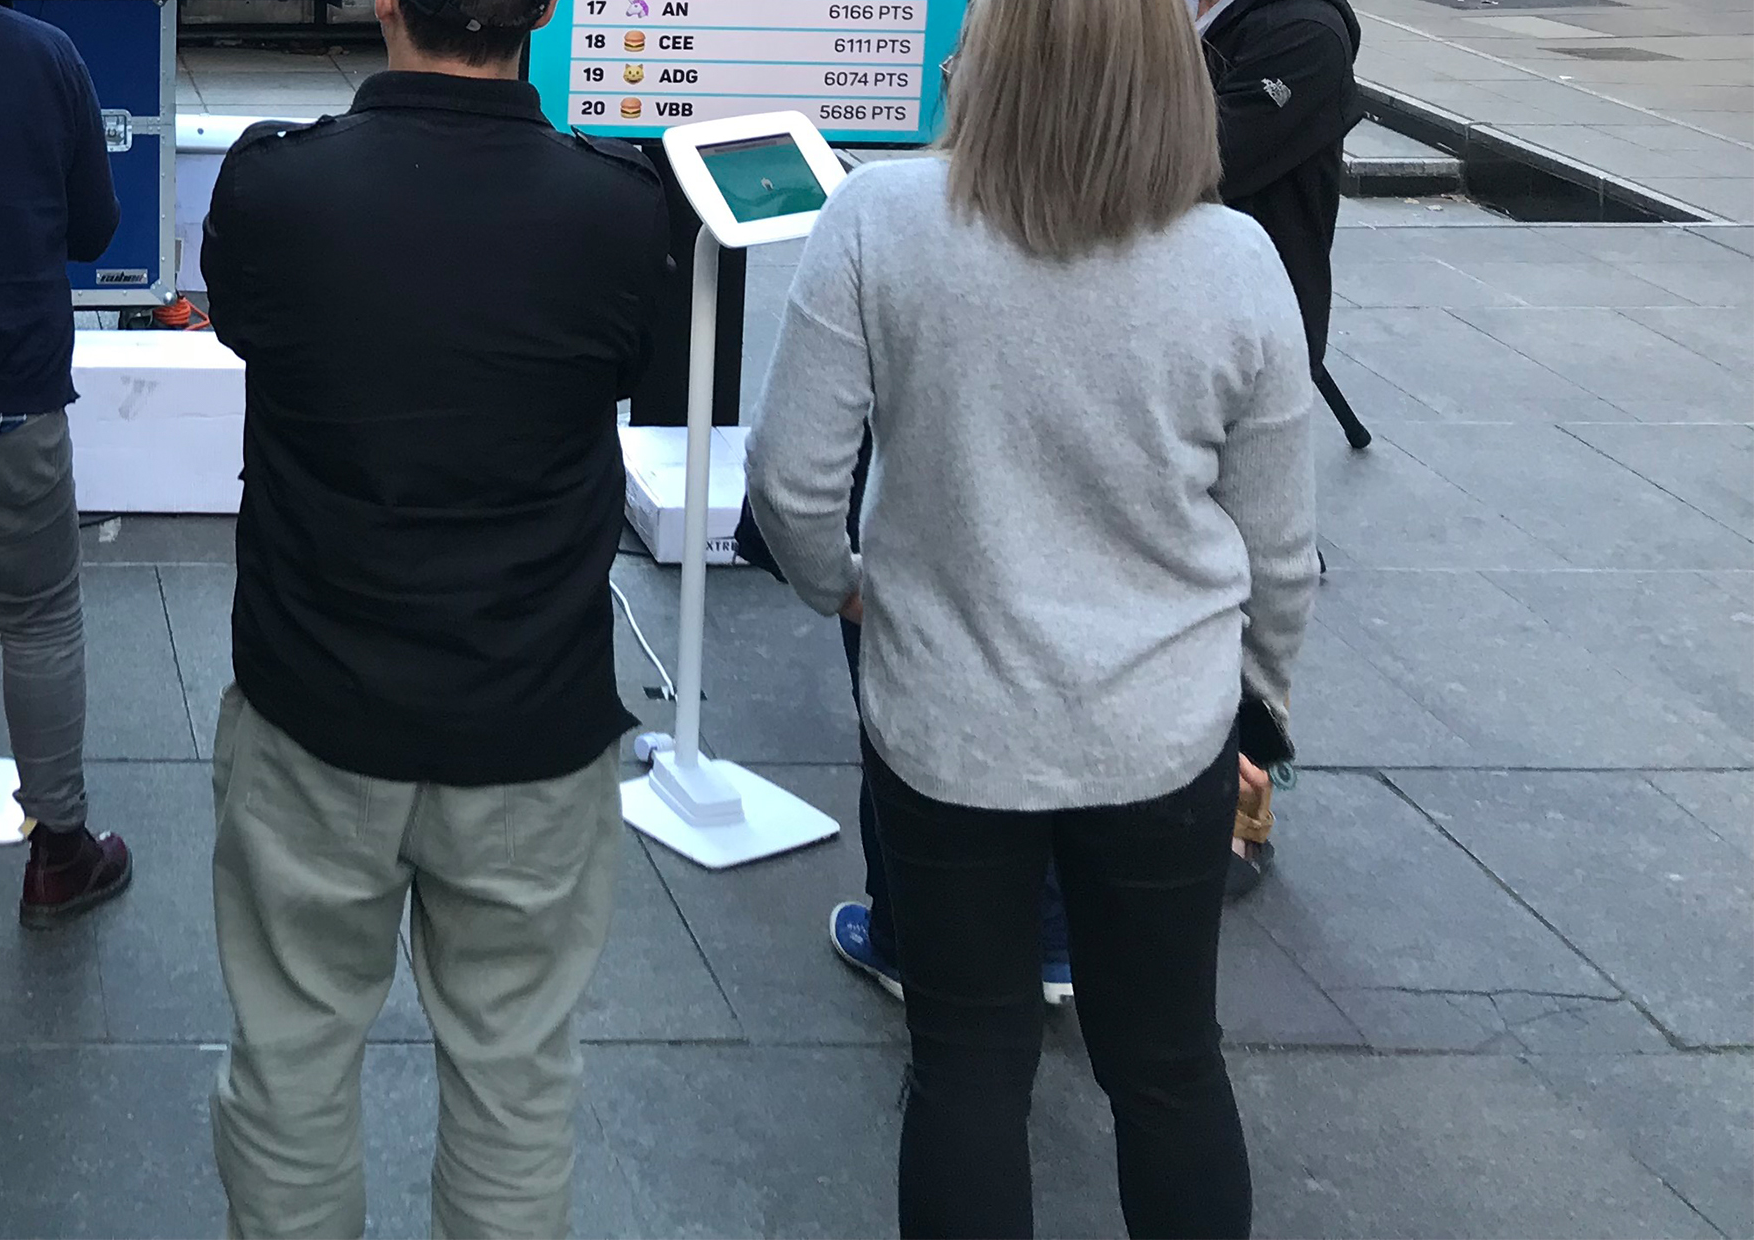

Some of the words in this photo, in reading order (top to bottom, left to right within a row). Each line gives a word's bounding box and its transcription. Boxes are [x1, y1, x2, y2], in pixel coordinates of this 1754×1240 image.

[587, 1, 606, 14] 17
[662, 2, 688, 16] AN
[829, 5, 873, 19] 6166
[879, 6, 913, 20] PTS
[585, 34, 605, 48] 18
[659, 36, 693, 49] CEE
[835, 39, 870, 52] 6111
[877, 39, 910, 53] PTS
[584, 68, 603, 81] 19
[659, 69, 697, 83] ADG
[825, 72, 868, 86] 6074
[874, 73, 908, 87] PTS
[582, 101, 605, 115] 20
[656, 103, 692, 116] VBB
[820, 105, 866, 119] 5686
[872, 106, 906, 120] PTS
